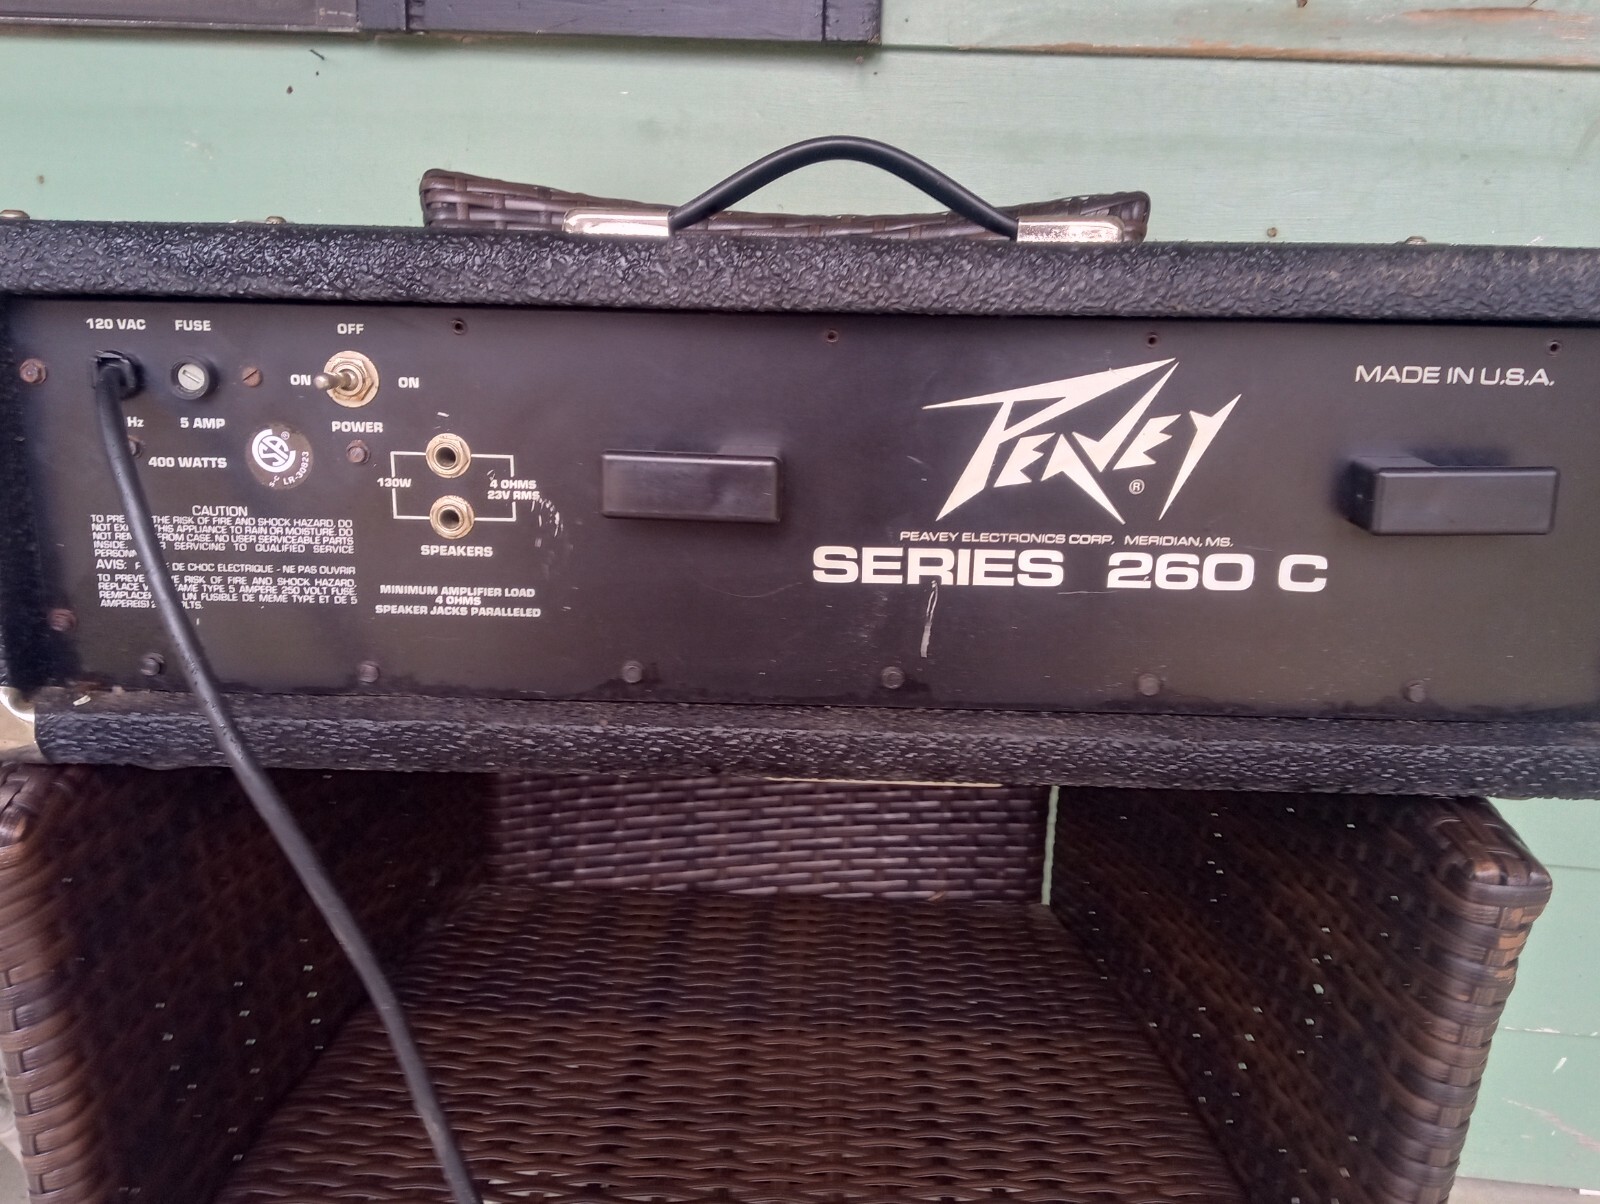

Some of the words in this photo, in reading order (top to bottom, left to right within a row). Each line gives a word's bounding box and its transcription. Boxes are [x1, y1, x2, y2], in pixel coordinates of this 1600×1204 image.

[86, 318, 114, 330] 120
[116, 318, 146, 331] VAC
[174, 319, 212, 331] FUSE
[336, 323, 364, 335] OFF
[290, 373, 312, 386] ON
[397, 376, 420, 389] ON
[1355, 364, 1441, 384] MADE
[1446, 366, 1475, 385] IN
[1479, 367, 1555, 387] U.S.A.
[126, 415, 145, 428] Hz
[180, 416, 189, 429] 5
[192, 417, 226, 430] AMP
[331, 420, 384, 434] POWER
[922, 357, 1242, 525] PEAVEY
[148, 456, 175, 468] 400
[177, 456, 228, 469] WATTS
[282, 451, 310, 486] LR-30823
[376, 477, 412, 488] 130W
[489, 479, 498, 489] 4
[500, 479, 537, 490] OHMS
[487, 490, 511, 501] 23V
[512, 490, 540, 502] RMS
[191, 504, 248, 518] CAUTION
[90, 514, 104, 523] TO
[151, 514, 171, 524] THE
[172, 515, 195, 524] RISK
[196, 516, 210, 525] OF
[212, 516, 233, 526] FIRE
[234, 516, 256, 526] AND
[257, 517, 292, 527] SHOCK
[337, 519, 353, 528] DO
[91, 523, 111, 532] NOT
[176, 524, 228, 535] APPLIANCE
[229, 525, 243, 534] TO
[244, 526, 268, 535] RAIN
[269, 527, 284, 536] OR
[338, 528, 354, 537] DO
[92, 531, 112, 540] NOT
[214, 534, 230, 543] NO
[231, 534, 257, 543] USER
[257, 535, 321, 545] SERVICEABLE
[322, 536, 355, 545] PARTS
[899, 531, 960, 543] PEAVEY
[961, 531, 1067, 545] ELECTRONICS
[1123, 535, 1204, 548] MERIDIAN,
[173, 541, 226, 551] SERVICING
[233, 543, 248, 552] TO
[254, 544, 306, 553] QUALIFIED
[312, 544, 355, 554] SERVICE
[420, 544, 494, 558] SPEAKERS
[95, 559, 128, 569] AVIS:
[171, 562, 186, 571] DE
[187, 562, 216, 571] CHOC
[217, 563, 274, 573] ELECTRIQUE
[282, 565, 297, 574] NE
[297, 565, 318, 574] PAS
[318, 565, 356, 575] OUVRIR
[811, 545, 1065, 587] SERIES
[1107, 551, 1256, 592] 260
[1277, 554, 1329, 593] C
[96, 573, 111, 582] TO
[114, 573, 146, 582] PREVE
[183, 575, 206, 584] RISK
[210, 575, 224, 584] OF
[227, 576, 248, 585] FIRE
[251, 576, 273, 585] AND
[276, 577, 311, 587] SHOCK
[97, 581, 141, 591] REPLACE
[174, 583, 199, 592] AME
[201, 584, 226, 593] TYPE
[228, 584, 236, 593] 5
[238, 585, 278, 594] AMPERE
[281, 585, 301, 595] 250
[303, 587, 328, 596] VOLT
[379, 585, 439, 596] MINIMUM
[440, 587, 502, 598] AMPLIFIER
[504, 588, 536, 598] LOAD
[181, 592, 198, 601] UN
[200, 592, 239, 602] FUSIBLE
[241, 593, 256, 602] DE
[258, 593, 289, 603] MEME
[291, 595, 316, 604] TYPE
[318, 594, 331, 604] ET
[333, 595, 348, 604] DE
[350, 596, 358, 605] 5
[434, 596, 444, 605] 4
[445, 597, 482, 606] OHMS
[374, 604, 429, 615] SPEAKER
[429, 606, 469, 617] JACKS
[470, 608, 542, 618] PARALLELED
